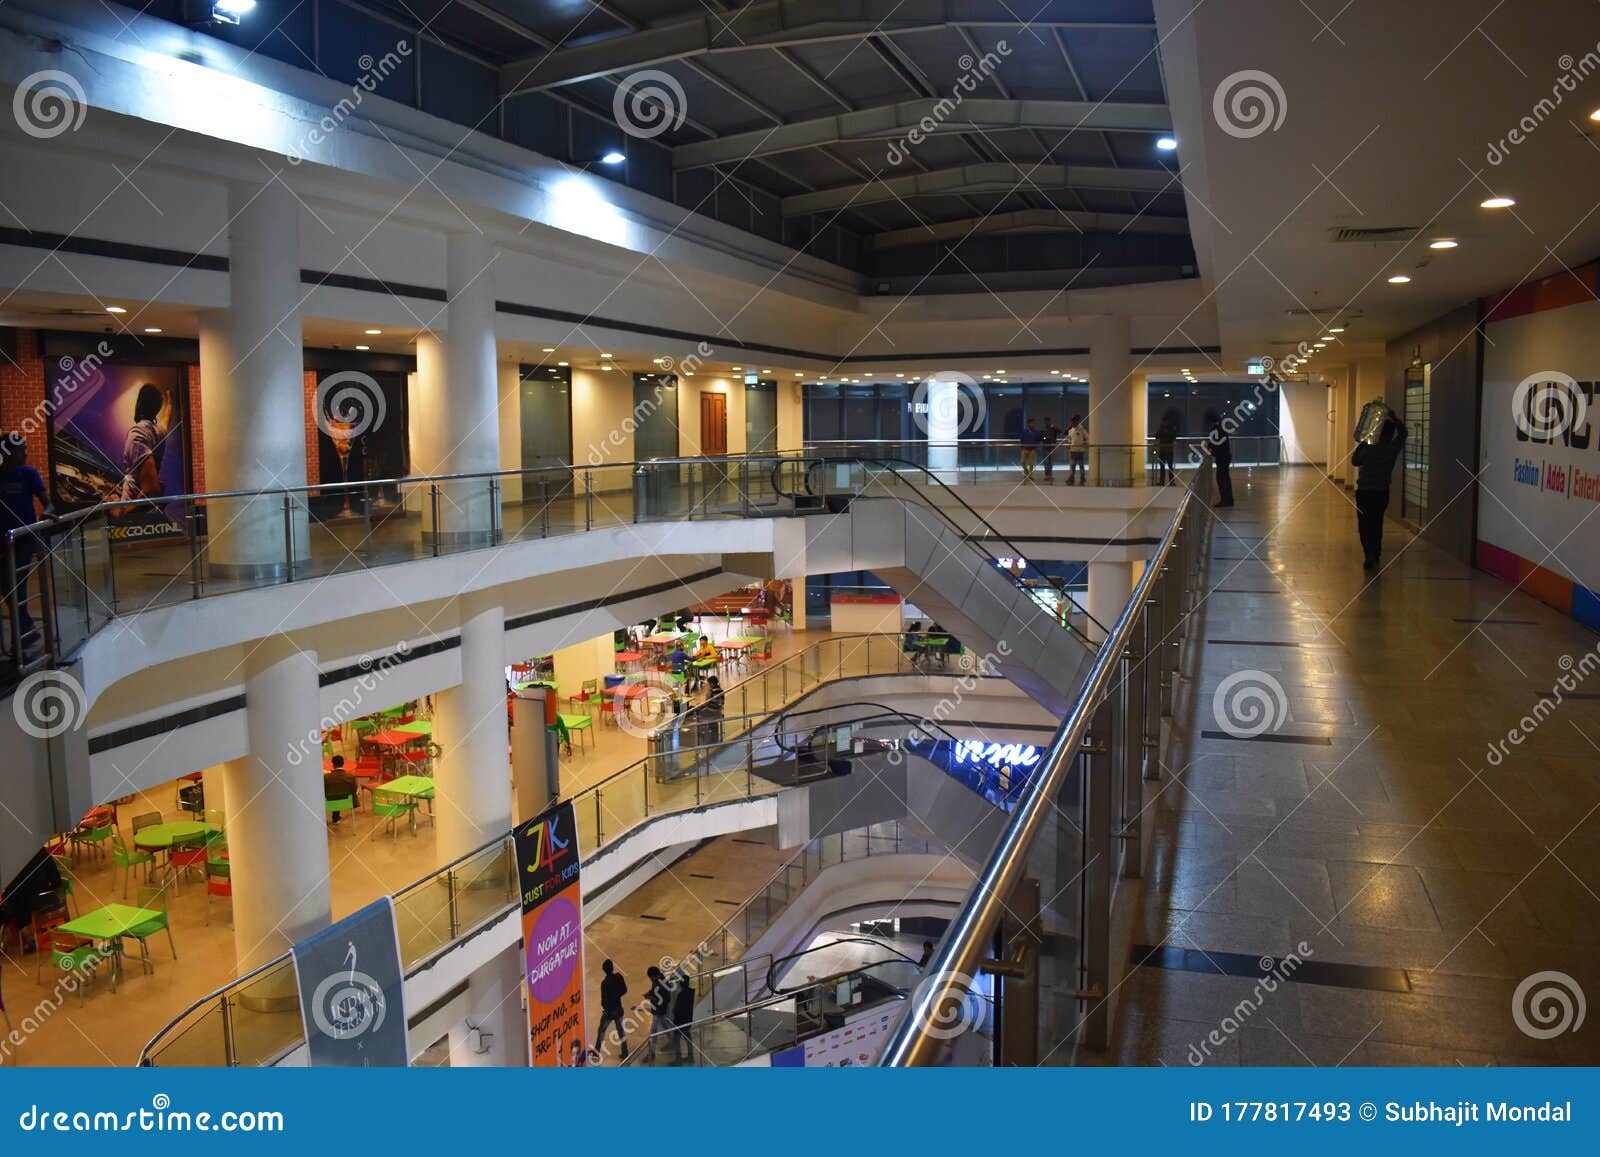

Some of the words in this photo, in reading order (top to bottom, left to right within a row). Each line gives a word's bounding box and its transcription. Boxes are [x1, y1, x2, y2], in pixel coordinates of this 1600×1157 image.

[1514, 457, 1539, 487] Fashion
[1546, 463, 1565, 493] Adda
[126, 522, 183, 537] COCKTAIL
[527, 816, 568, 872] J4K
[523, 883, 545, 906] JUST
[544, 874, 560, 892] FOR
[561, 862, 579, 880] KIDS
[537, 929, 558, 956] NOW
[559, 920, 572, 939] AT
[530, 1014, 551, 1042] SHOP
[552, 1012, 580, 1043] FLOOR
